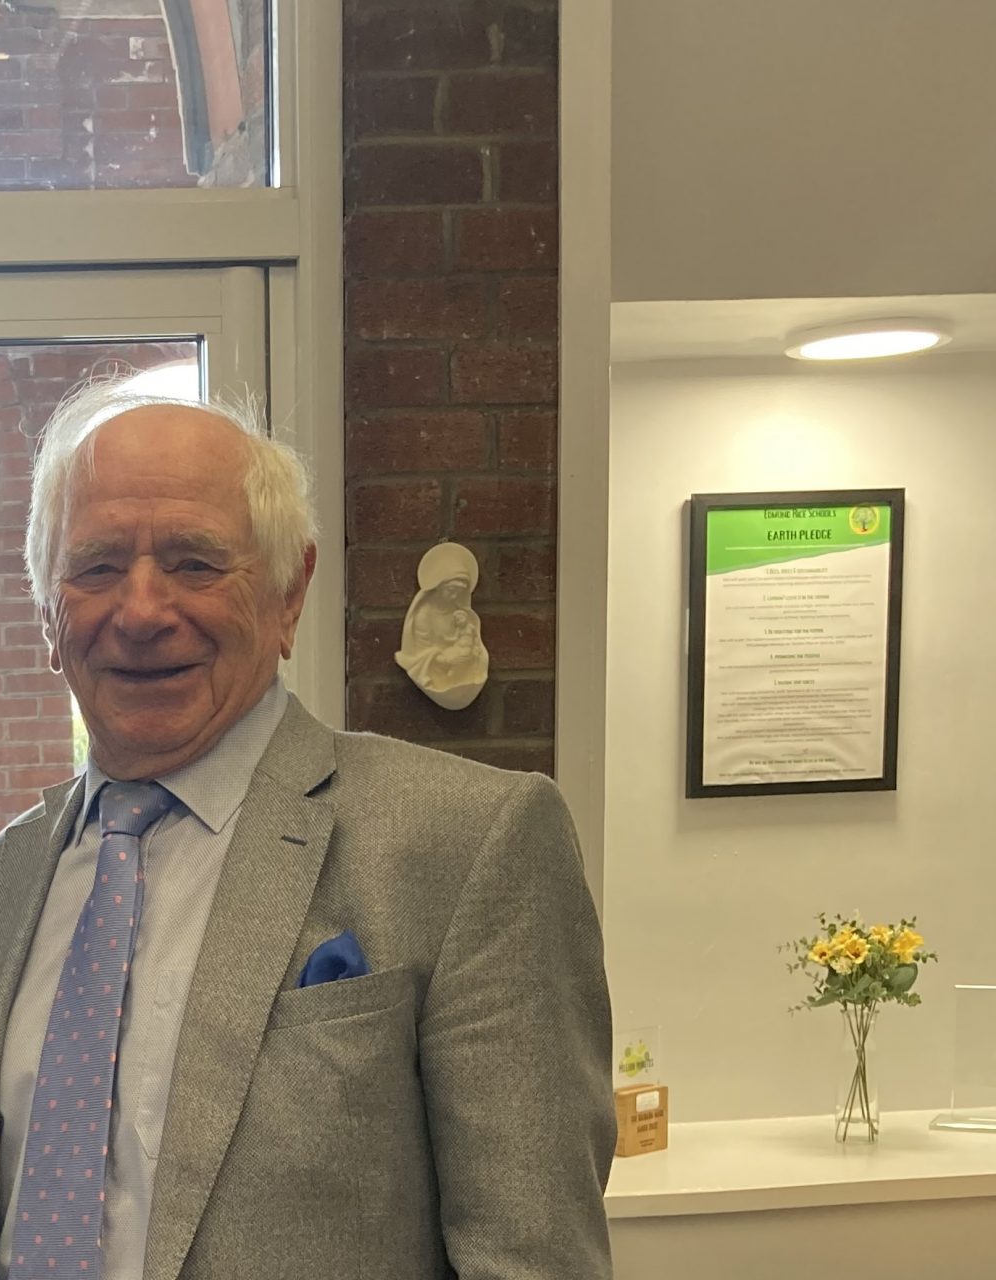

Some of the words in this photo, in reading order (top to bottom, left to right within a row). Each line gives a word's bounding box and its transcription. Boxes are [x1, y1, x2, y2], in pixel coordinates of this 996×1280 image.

[792, 508, 807, 519] RICE
[808, 508, 837, 519] SCHOOLS
[767, 530, 797, 541] EARTH
[799, 529, 833, 540] PLEDGE
